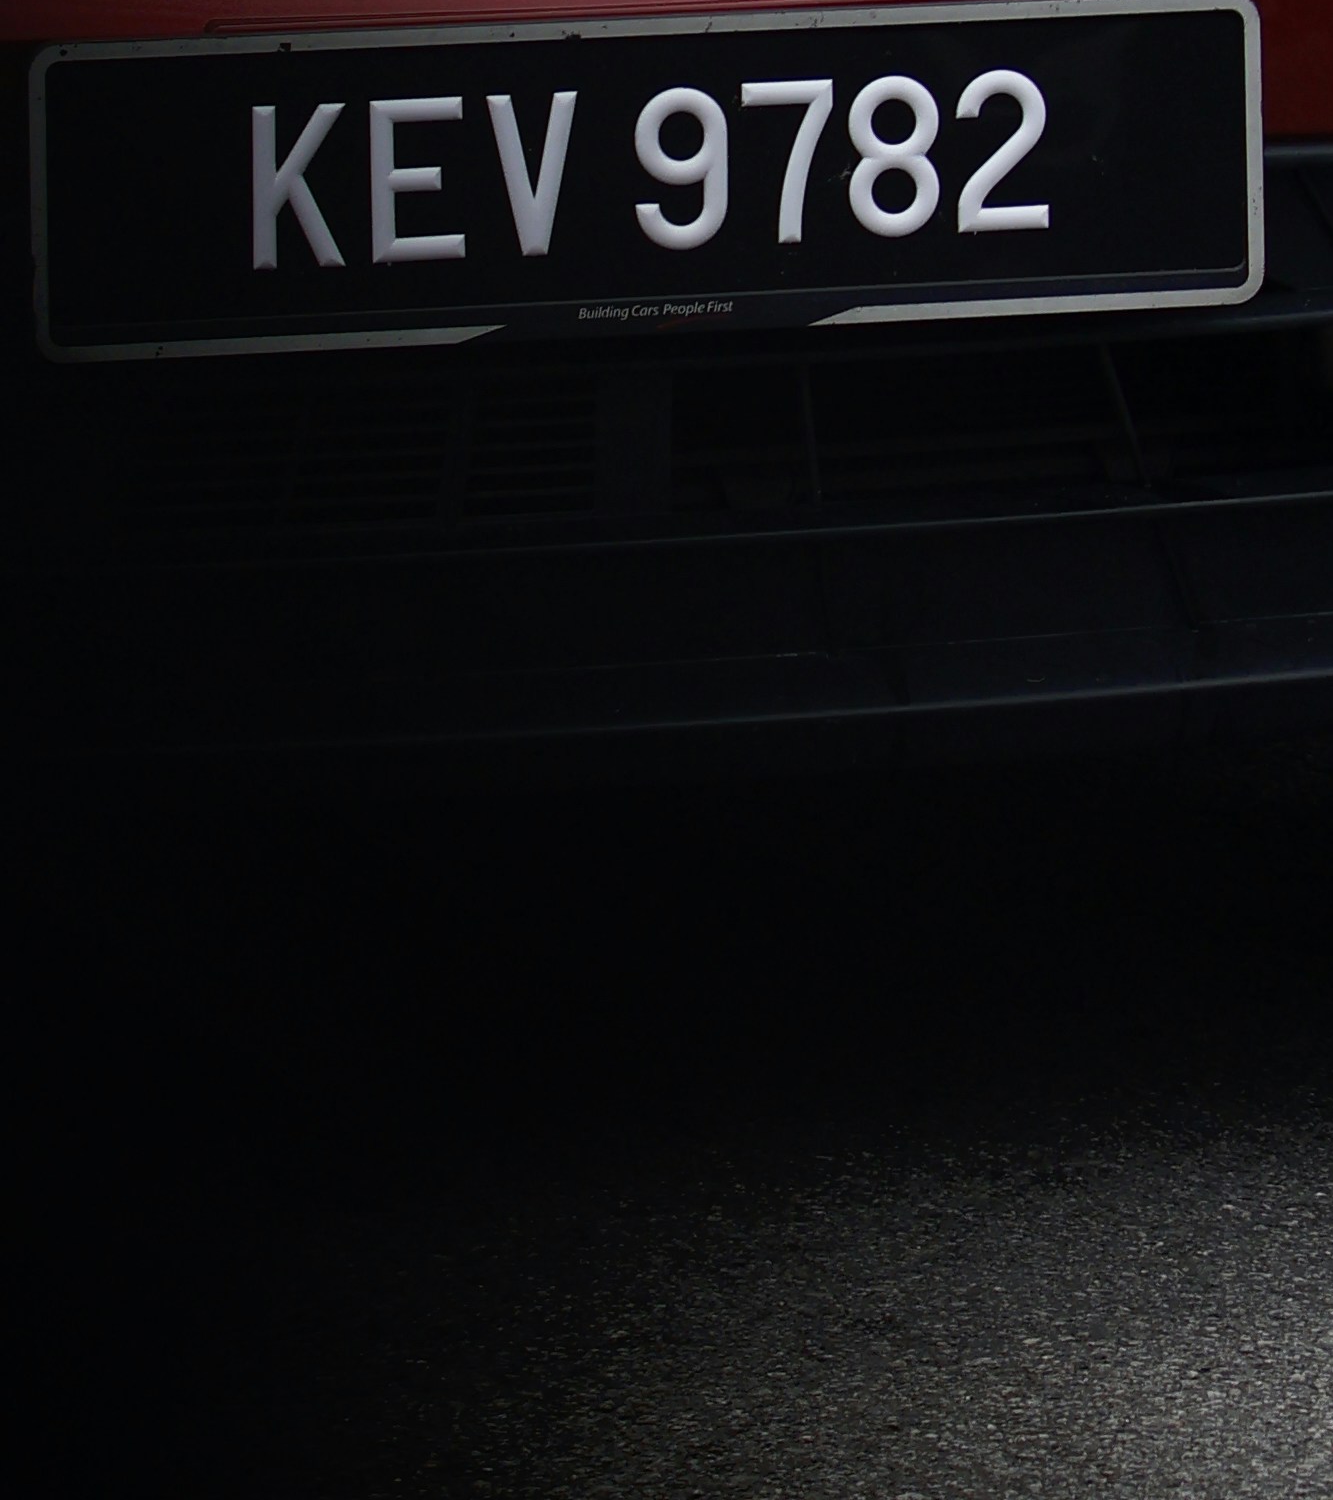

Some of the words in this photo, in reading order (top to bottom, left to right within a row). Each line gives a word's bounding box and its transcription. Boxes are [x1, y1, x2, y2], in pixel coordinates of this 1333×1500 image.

[250, 89, 579, 271] KEV
[633, 68, 1051, 251] 9782
[578, 305, 630, 321] Building
[631, 304, 660, 318] Cars
[663, 301, 706, 317] People
[707, 300, 734, 314] First
